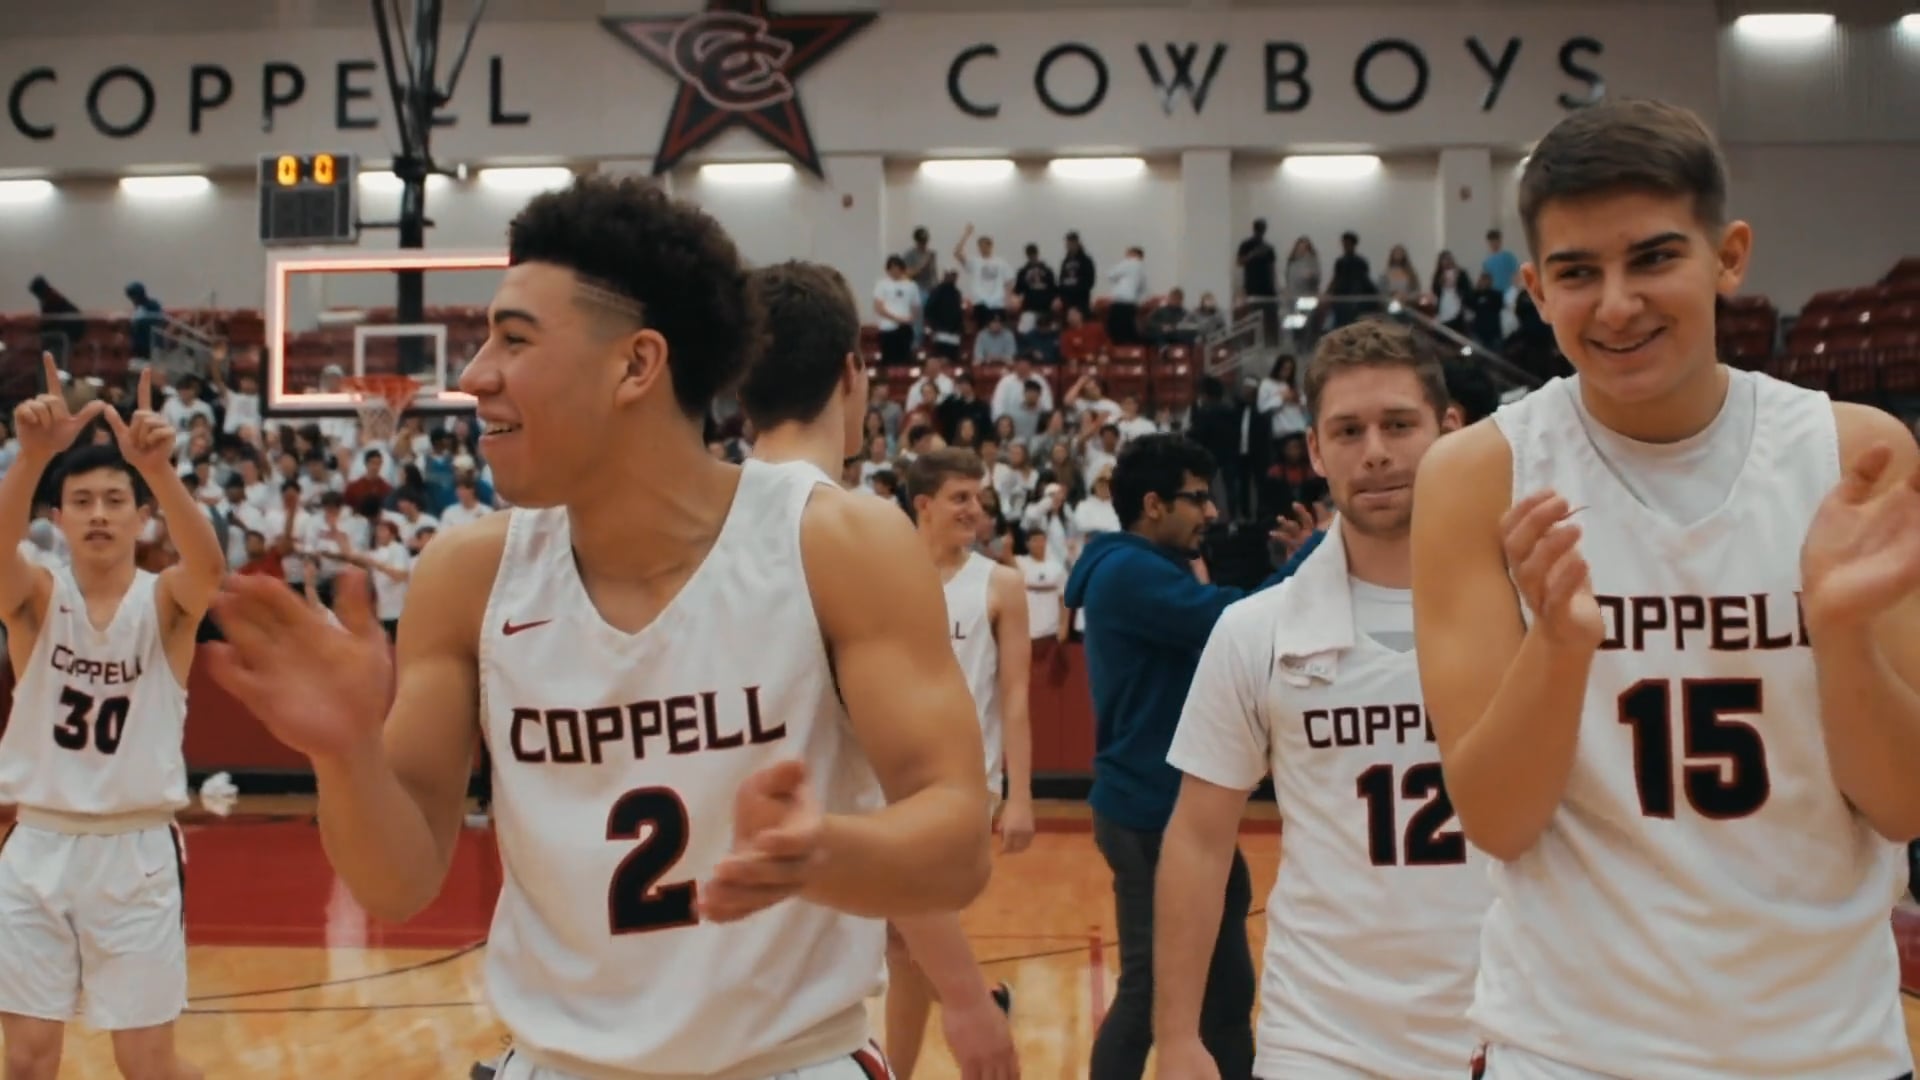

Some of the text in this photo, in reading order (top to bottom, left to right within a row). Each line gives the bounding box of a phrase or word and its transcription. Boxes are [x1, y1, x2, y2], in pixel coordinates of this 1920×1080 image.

[8, 36, 1607, 140] COPPEL COWBOYS
[53, 684, 130, 756] 30
[509, 685, 787, 765] COPPELL
[1616, 677, 1772, 820] 15
[605, 785, 700, 936] 2
[1356, 761, 1467, 867] 12
